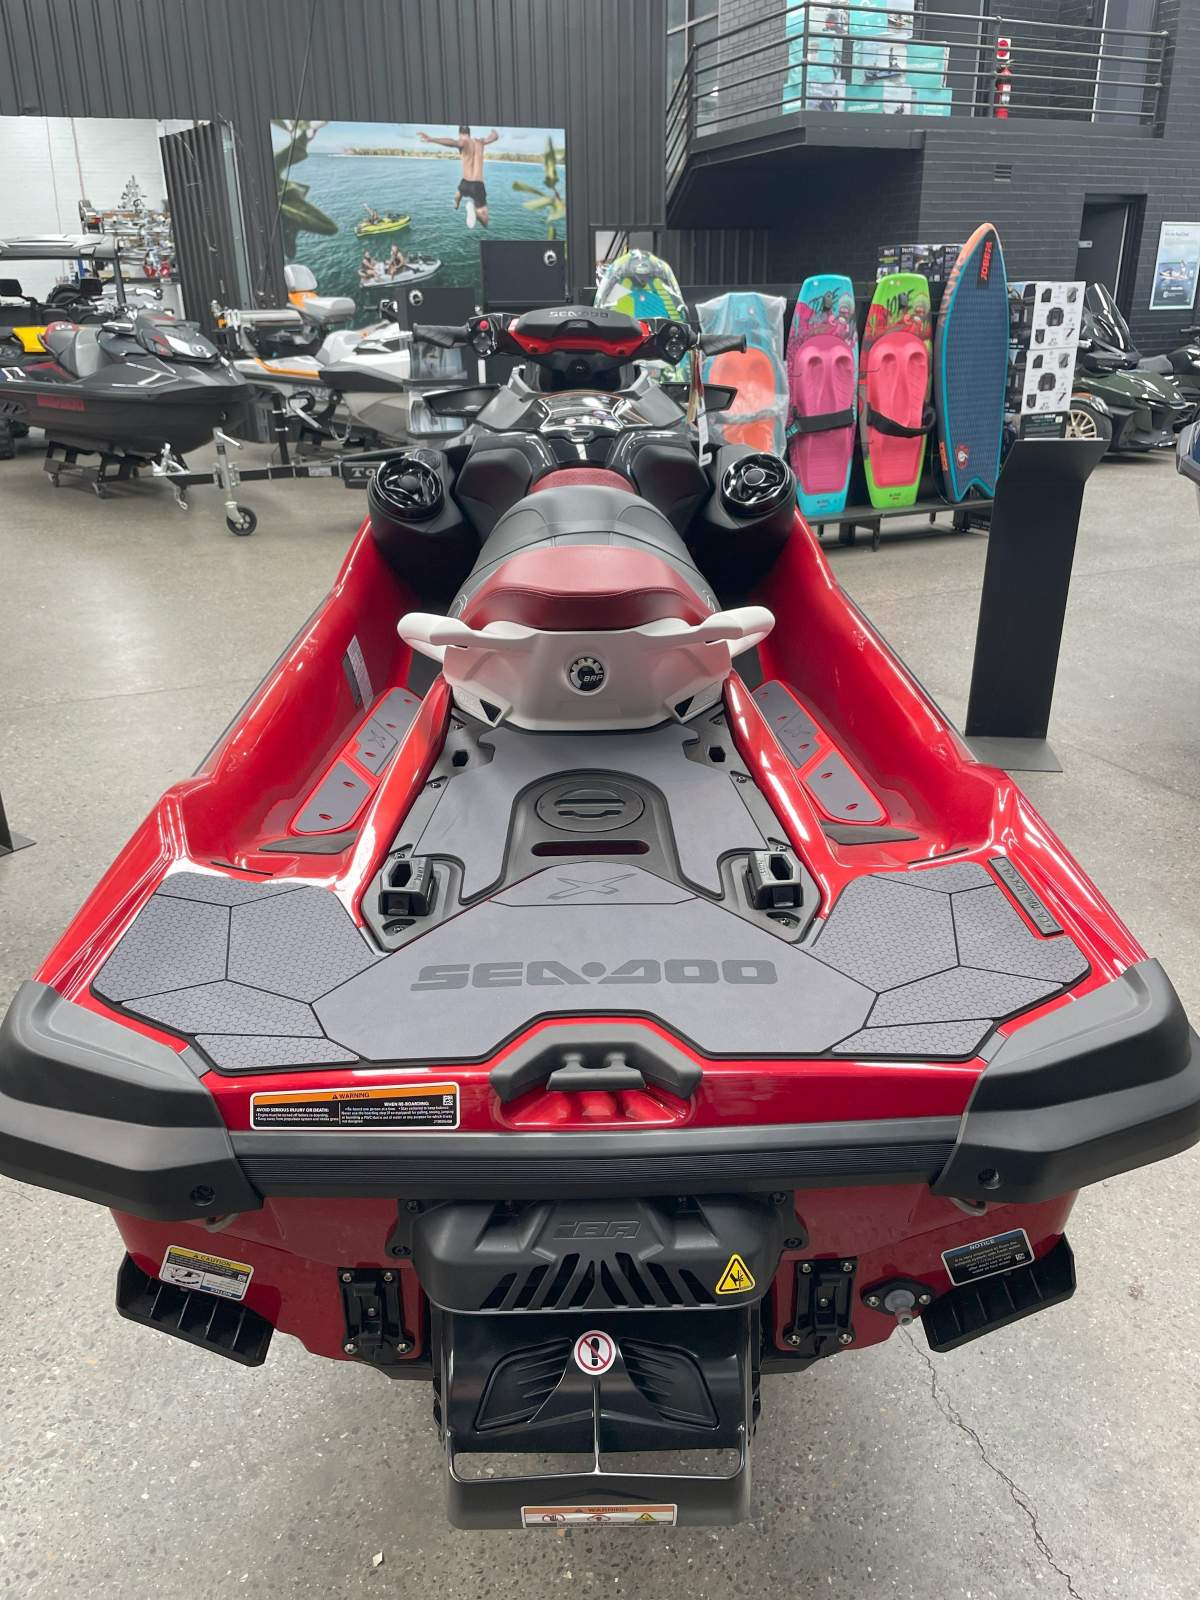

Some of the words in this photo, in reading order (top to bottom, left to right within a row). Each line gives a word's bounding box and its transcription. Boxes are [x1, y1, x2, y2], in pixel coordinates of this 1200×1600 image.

[583, 674, 604, 682] BRP
[339, 1092, 370, 1100] WARNING
[970, 1239, 995, 1250] NOTICE
[200, 1254, 232, 1267] CAUTION
